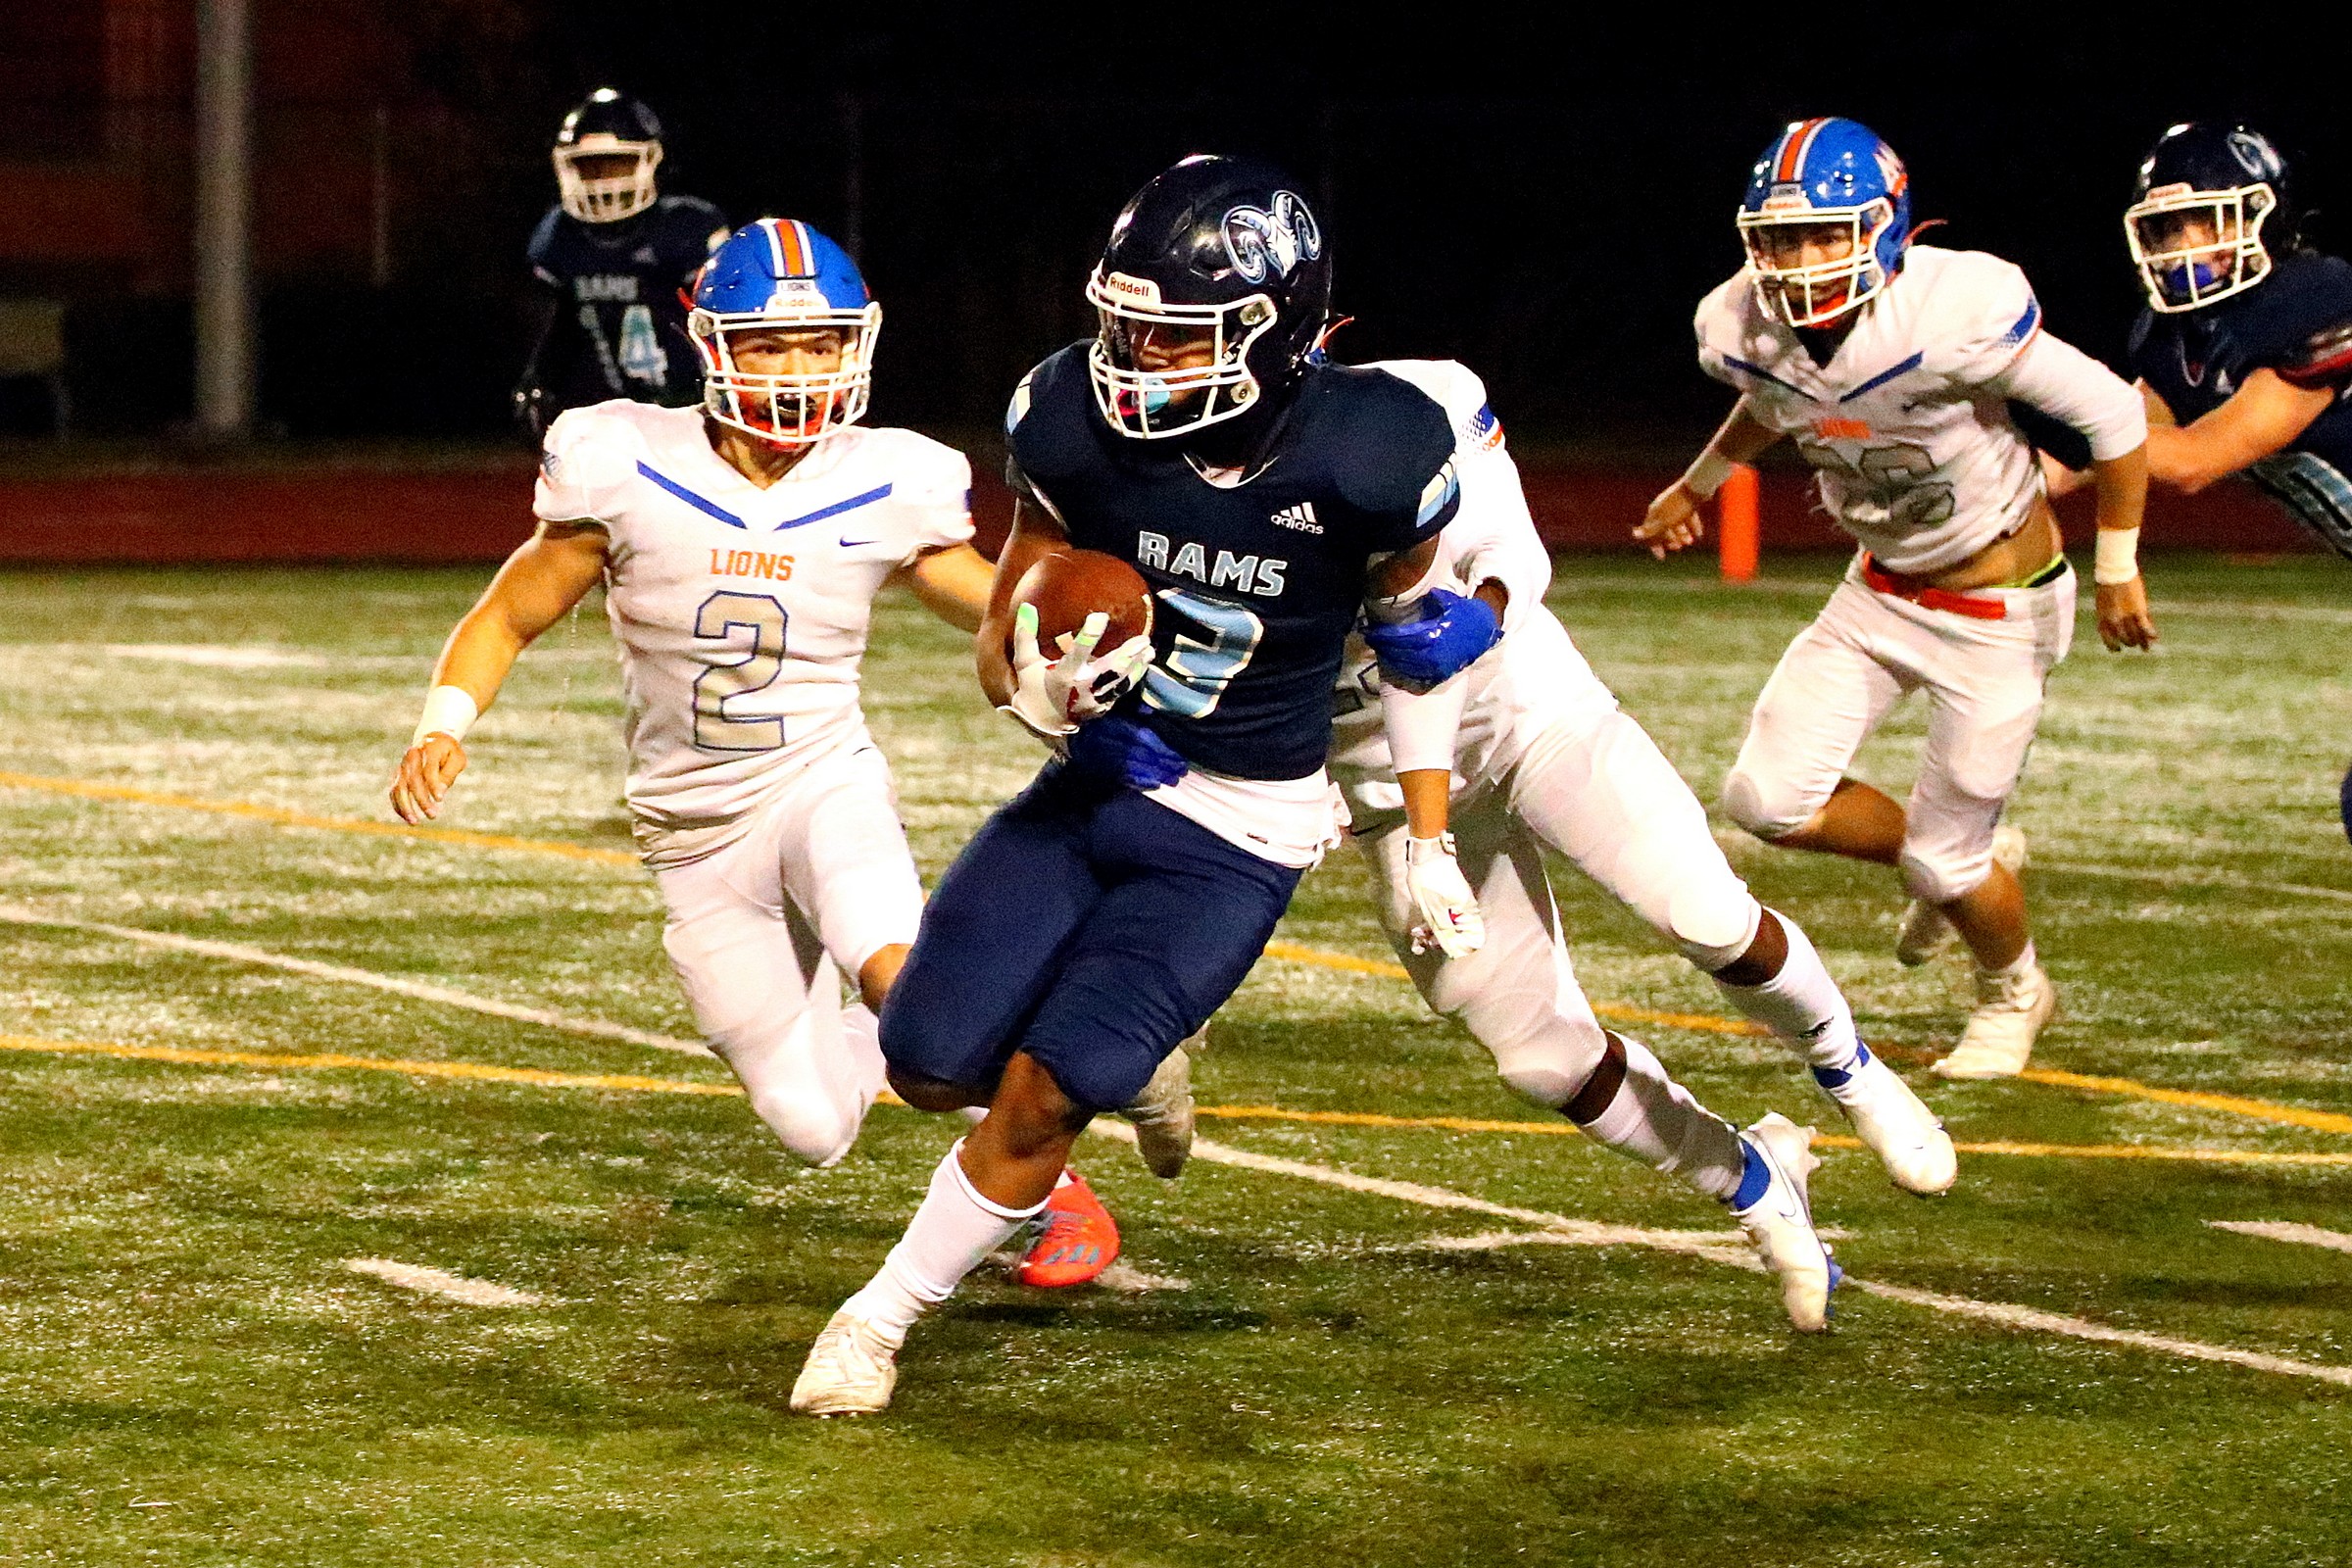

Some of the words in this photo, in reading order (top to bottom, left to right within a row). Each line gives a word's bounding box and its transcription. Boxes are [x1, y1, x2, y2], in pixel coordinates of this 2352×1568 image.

[1109, 276, 1150, 297] Riddell
[774, 298, 821, 308] Ridde
[1270, 514, 1325, 535] adidas
[708, 548, 797, 581] LIONS
[1138, 530, 1289, 597] RAMS
[693, 590, 789, 753] 2
